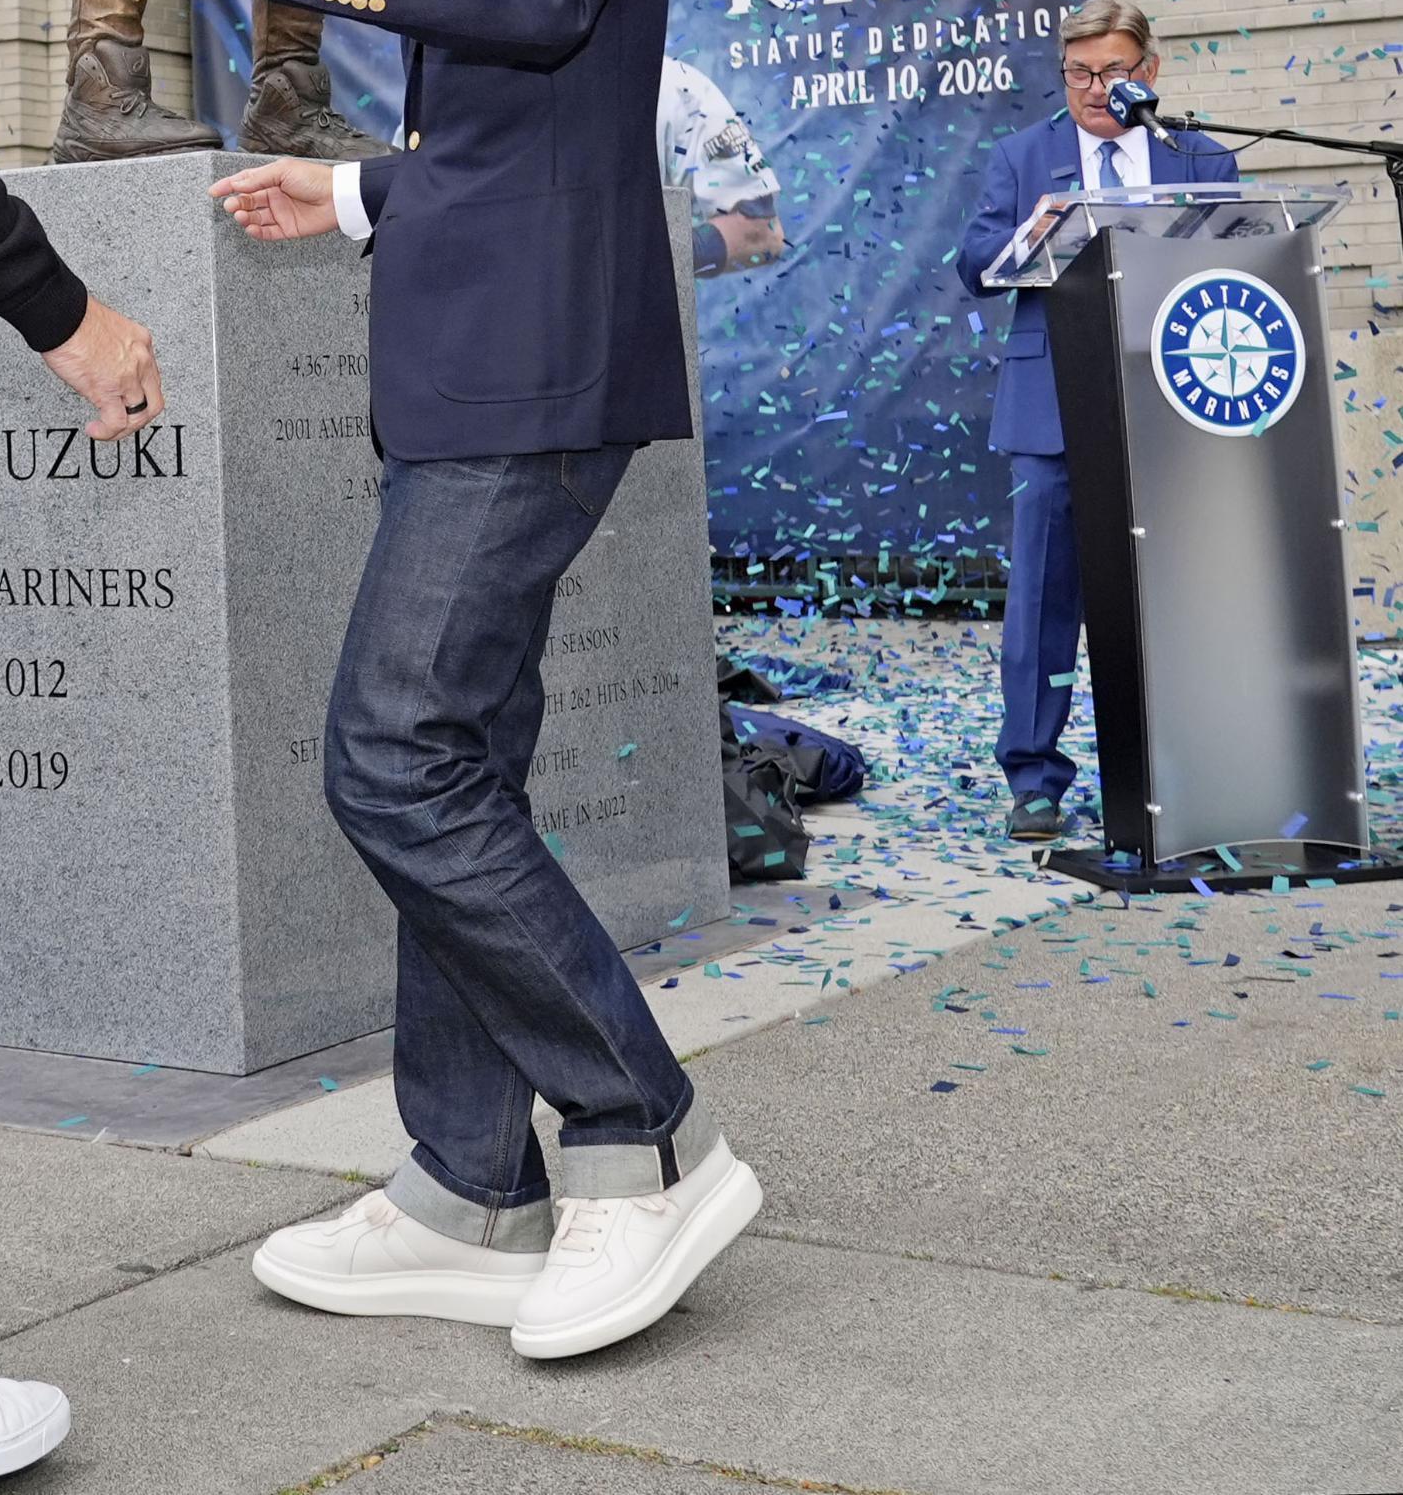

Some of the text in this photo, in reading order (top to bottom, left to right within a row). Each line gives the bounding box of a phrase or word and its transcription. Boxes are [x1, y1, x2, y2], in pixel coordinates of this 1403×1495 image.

[729, 31, 845, 69] STATUE
[790, 54, 1014, 110] APRIL 10, 2026
[1169, 284, 1284, 338] SEATTLE
[292, 353, 369, 378] 4,367 PRO
[1172, 365, 1290, 421] MARINERS
[275, 414, 371, 441] 2001 AMERI
[344, 478, 355, 500] 2
[554, 574, 583, 599] RDS
[562, 625, 621, 655] SEASONS
[570, 687, 592, 711] 262
[597, 681, 628, 706] HITS
[631, 677, 647, 700] IN
[652, 672, 680, 696] 2004
[290, 736, 319, 765] SET
[553, 747, 580, 772] THE
[533, 794, 628, 835] FAME IN 2022
